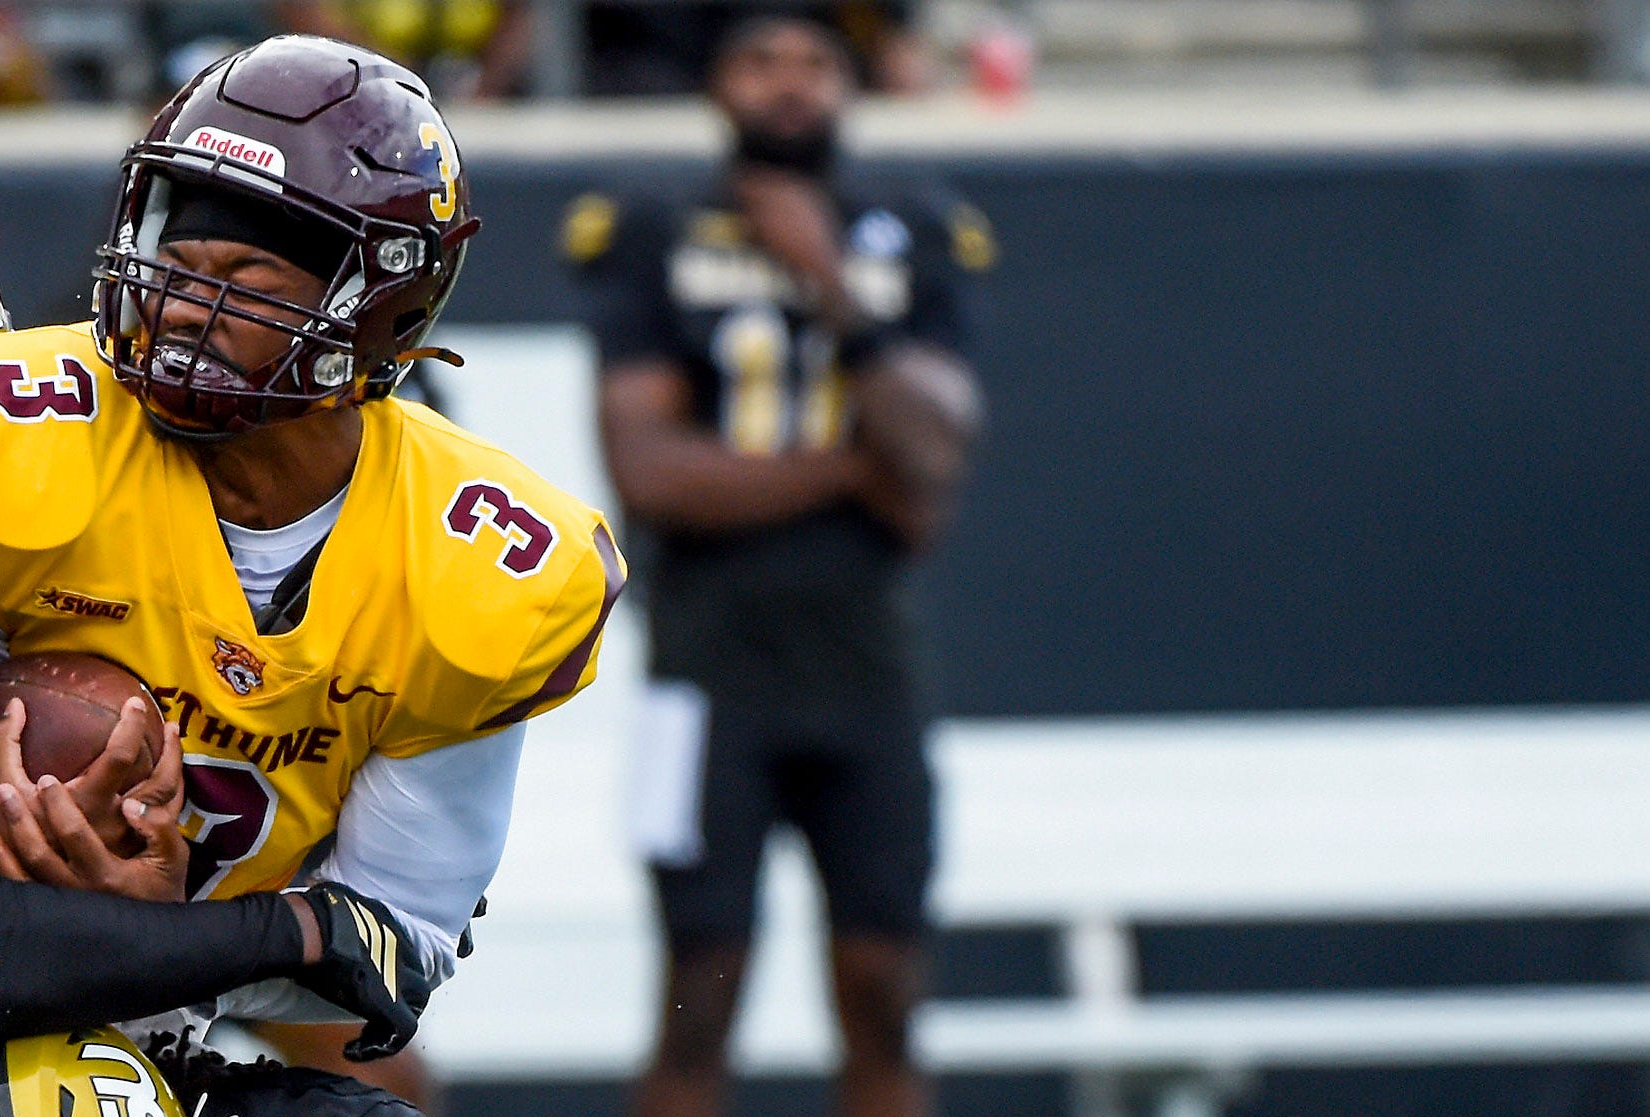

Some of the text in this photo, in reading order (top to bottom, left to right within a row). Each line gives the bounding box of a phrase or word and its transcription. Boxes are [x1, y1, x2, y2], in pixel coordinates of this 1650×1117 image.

[195, 131, 274, 168] Riddell
[418, 121, 457, 222] 3
[441, 479, 560, 580] 3
[59, 595, 131, 620] SWAC
[151, 686, 341, 773] ETHUNE
